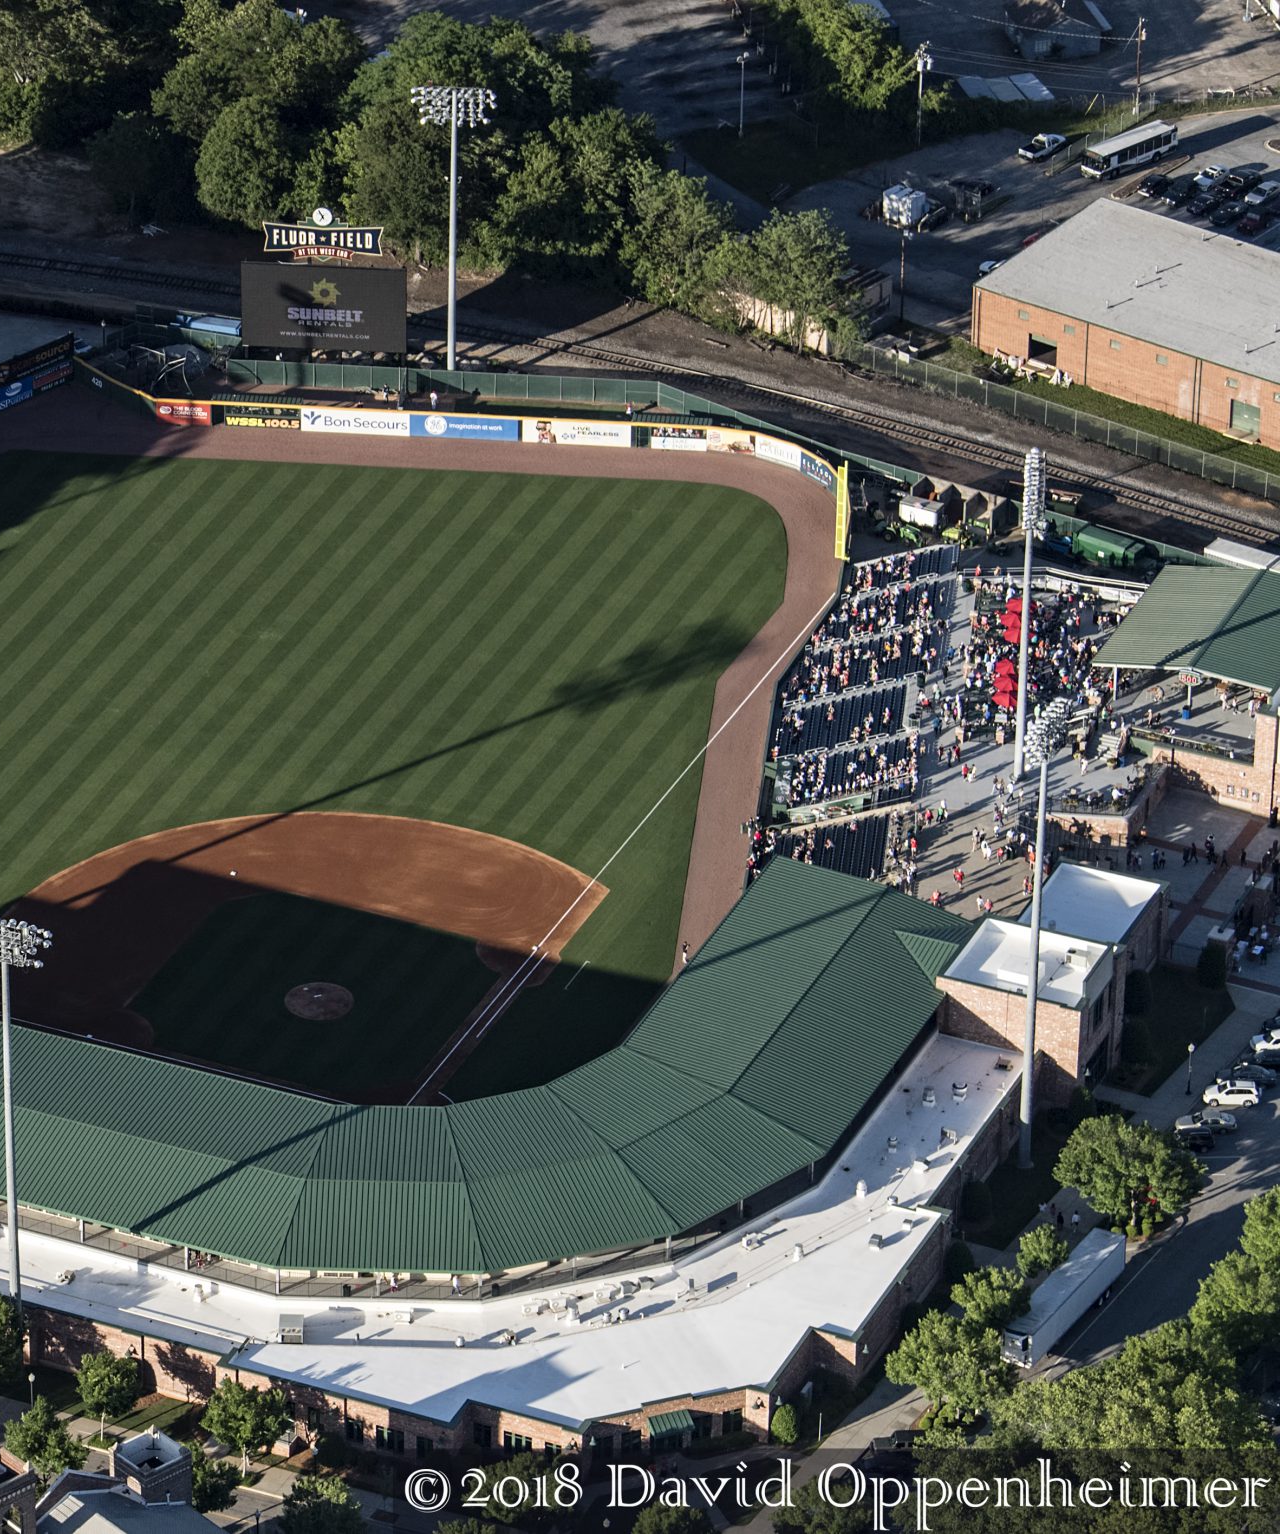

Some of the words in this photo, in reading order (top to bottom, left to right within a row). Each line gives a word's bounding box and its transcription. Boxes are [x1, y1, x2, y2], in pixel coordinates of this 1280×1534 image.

[272, 228, 316, 246] FLUOR
[330, 231, 373, 249] FIELD
[307, 247, 318, 255] THE
[319, 247, 335, 256] WEST
[287, 306, 363, 323] SUNBELT
[297, 320, 352, 328] RENTALS
[91, 376, 103, 389] 420
[324, 415, 351, 428] Bon
[353, 416, 408, 430] Secours
[449, 422, 481, 431] imagination
